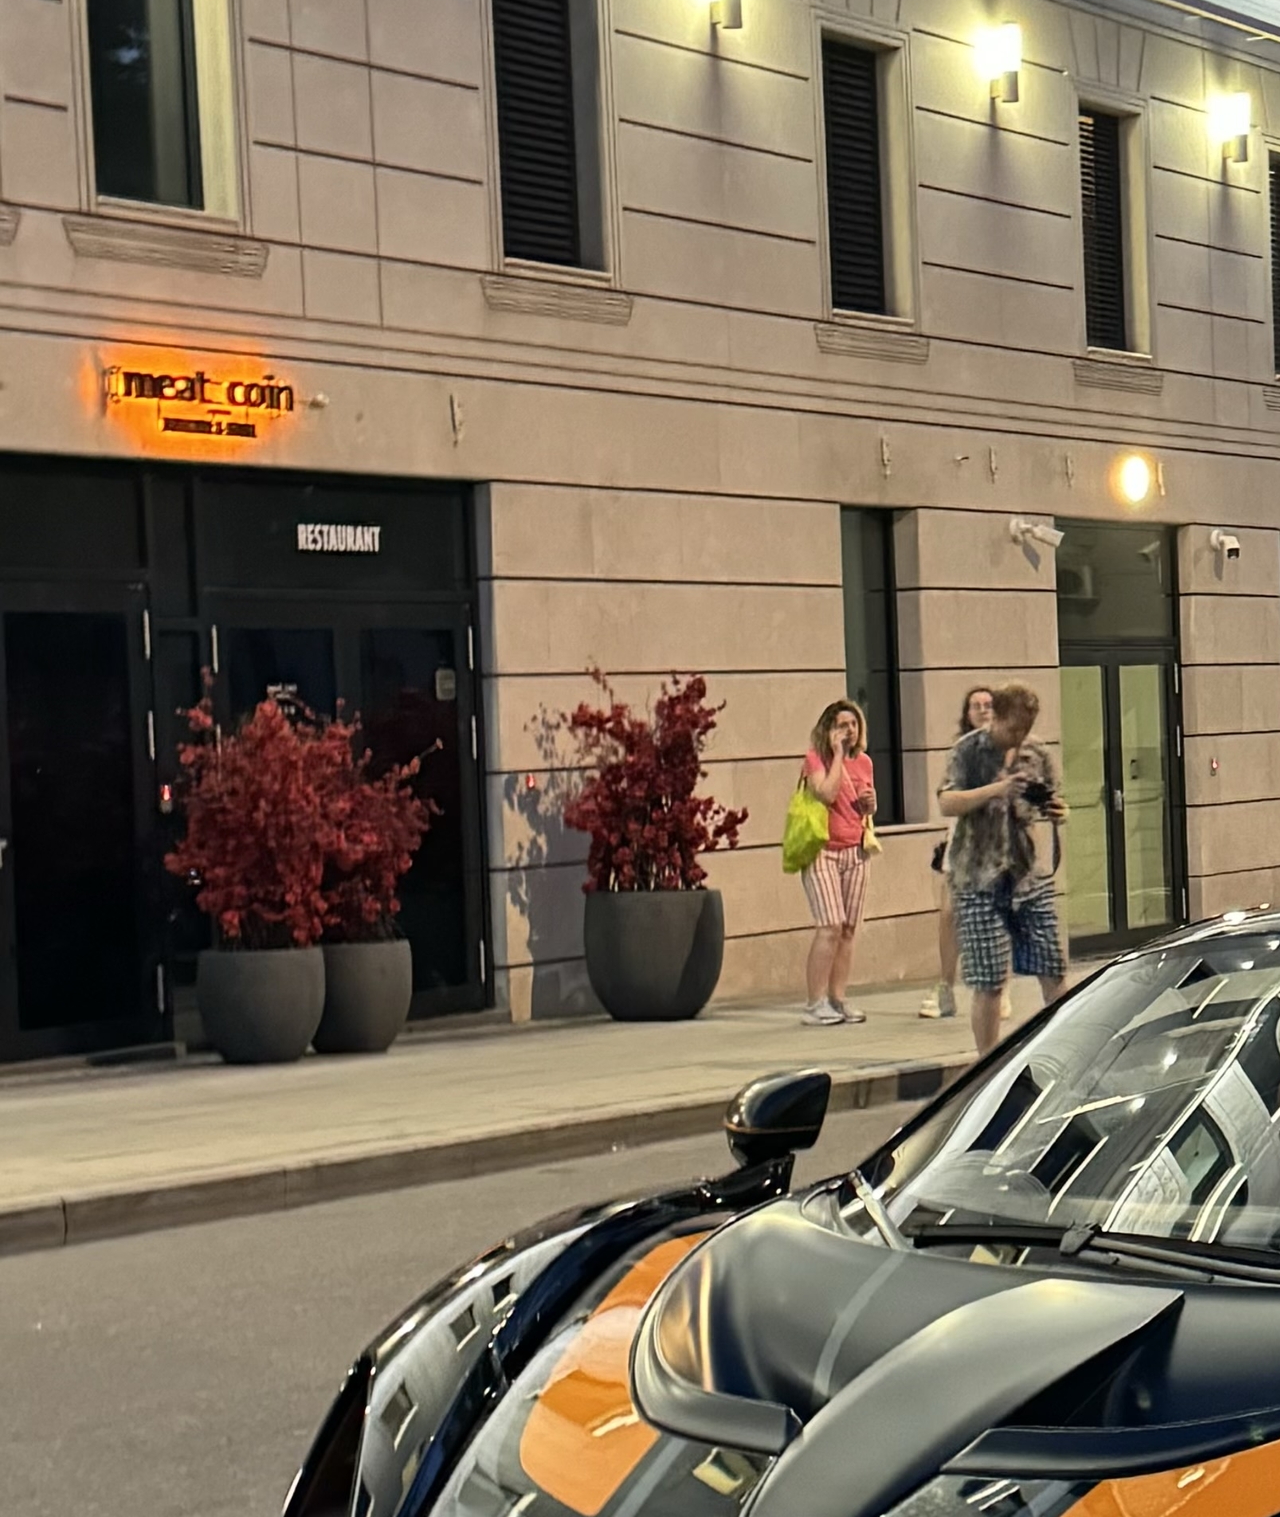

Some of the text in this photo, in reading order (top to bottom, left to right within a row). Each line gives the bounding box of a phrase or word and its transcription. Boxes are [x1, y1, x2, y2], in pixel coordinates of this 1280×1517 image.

[123, 371, 294, 411] meat coin
[297, 523, 381, 553] RESTAURANT
